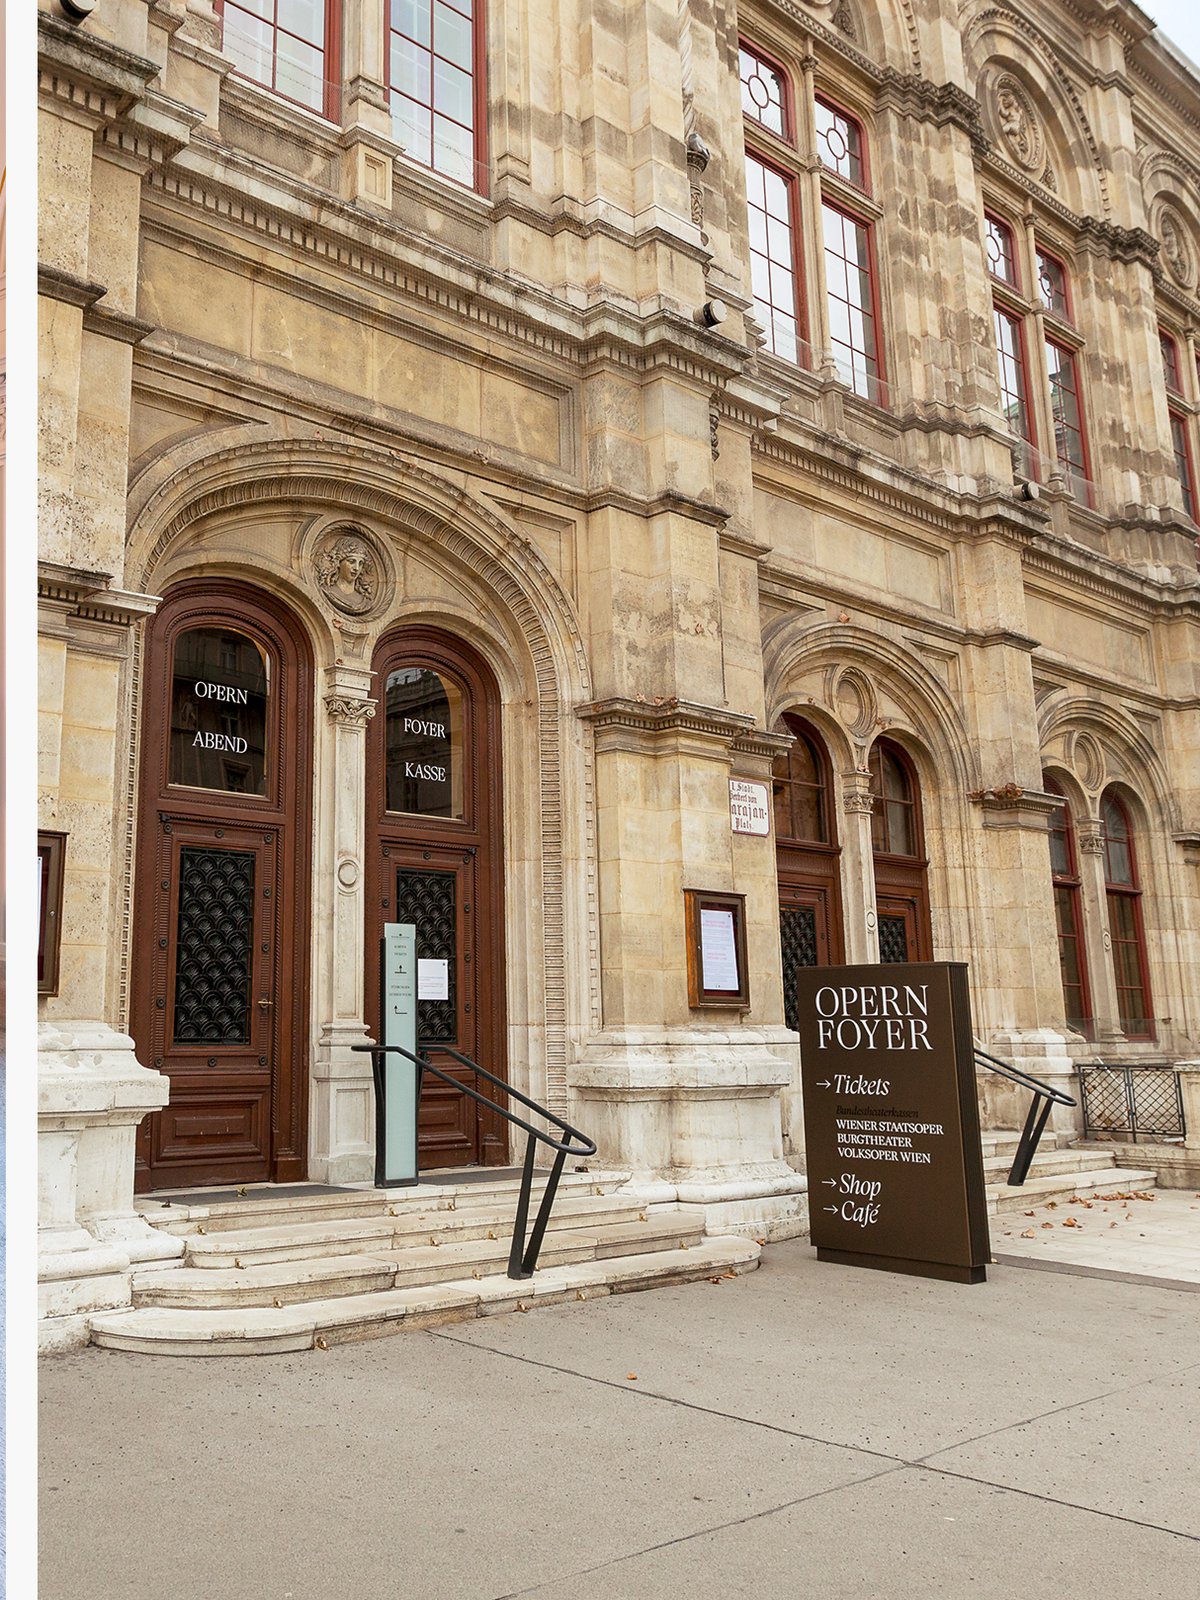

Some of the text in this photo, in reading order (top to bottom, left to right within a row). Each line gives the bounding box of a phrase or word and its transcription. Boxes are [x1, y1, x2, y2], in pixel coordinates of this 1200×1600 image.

[194, 681, 248, 705] OPERN
[403, 717, 446, 739] FOYER
[192, 731, 248, 754] ABEND
[404, 762, 446, 783] KASSE
[731, 804, 767, 821] arajan-
[815, 985, 929, 1018] OPERN
[817, 1018, 934, 1050] FOYER
[834, 1074, 891, 1096] Tickets
[836, 1105, 919, 1119] Bundestheaterkassen
[836, 1119, 944, 1136] WIENER STAATSOPER
[837, 1133, 913, 1148] BURGTHEATER
[837, 1147, 931, 1164] VOLKSOPER WIEN
[839, 1173, 881, 1201] Shop
[841, 1200, 881, 1228] Café
